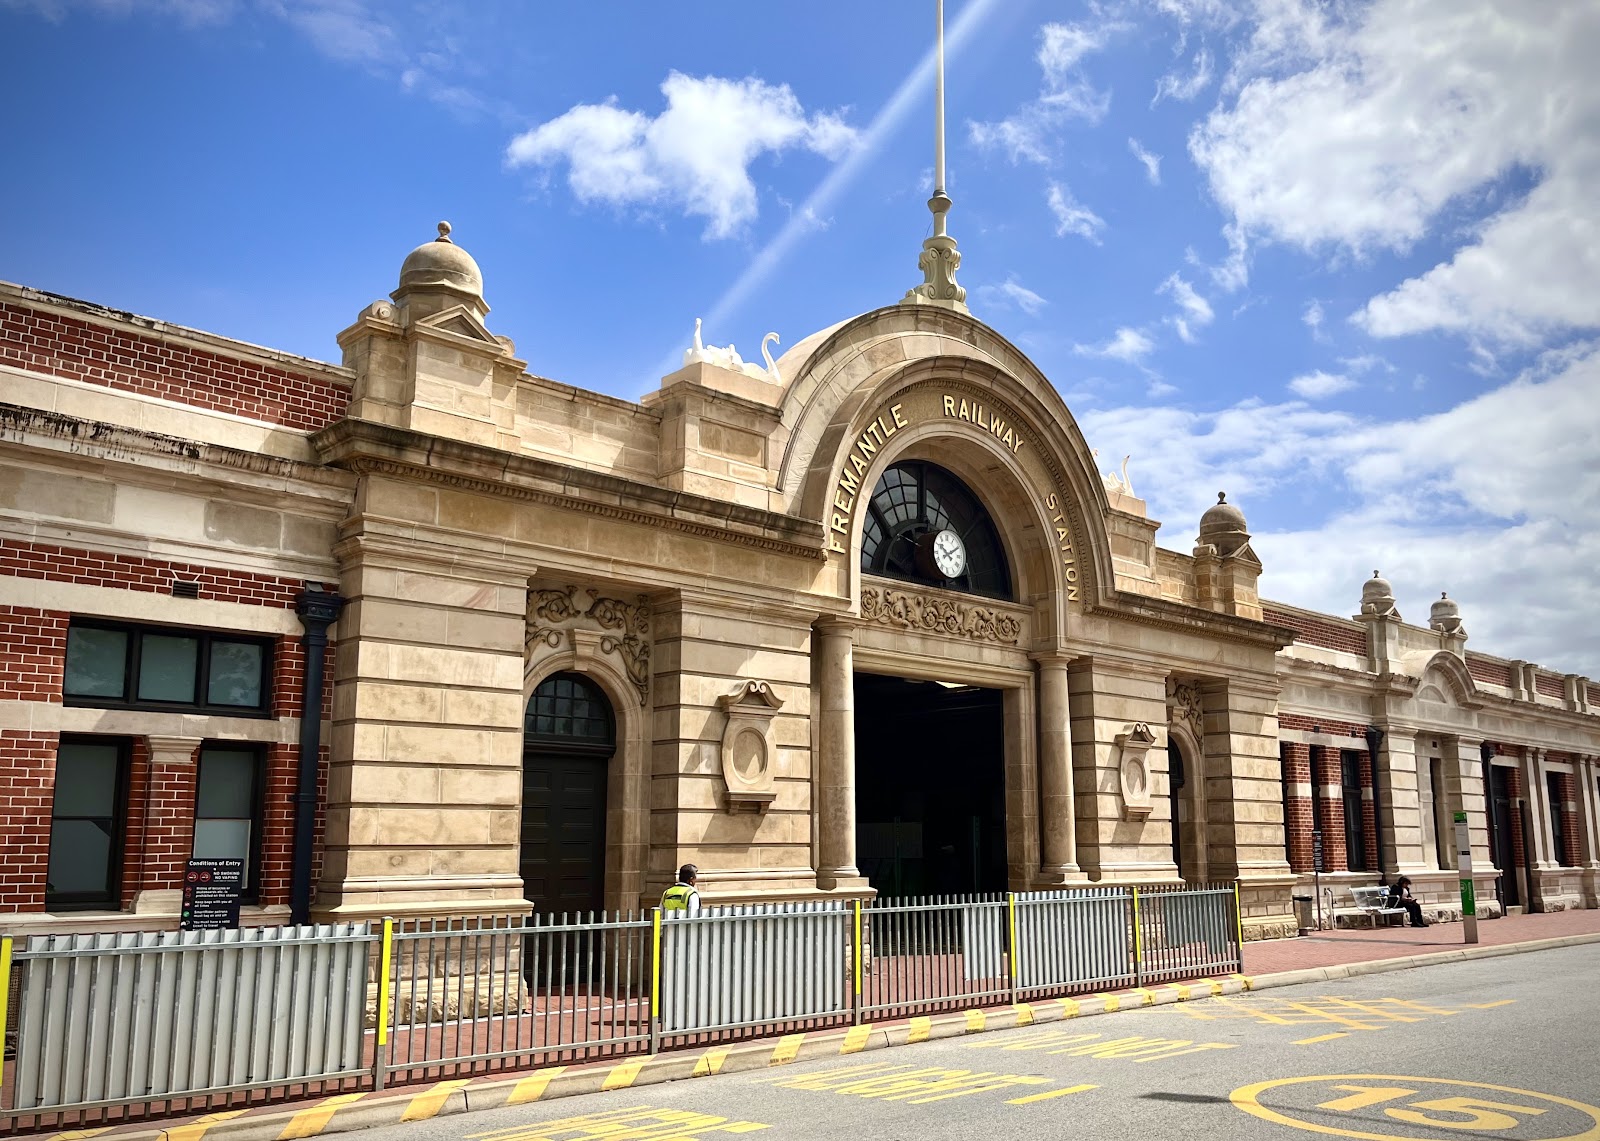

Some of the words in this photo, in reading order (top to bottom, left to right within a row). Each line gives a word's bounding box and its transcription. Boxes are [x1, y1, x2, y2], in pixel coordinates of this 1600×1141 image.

[829, 403, 908, 554] FREMANTLE
[942, 394, 1024, 454] RAILWAY
[1045, 492, 1079, 602] STATION
[1046, 1036, 1241, 1062] NOT
[1314, 1085, 1549, 1130] 15
